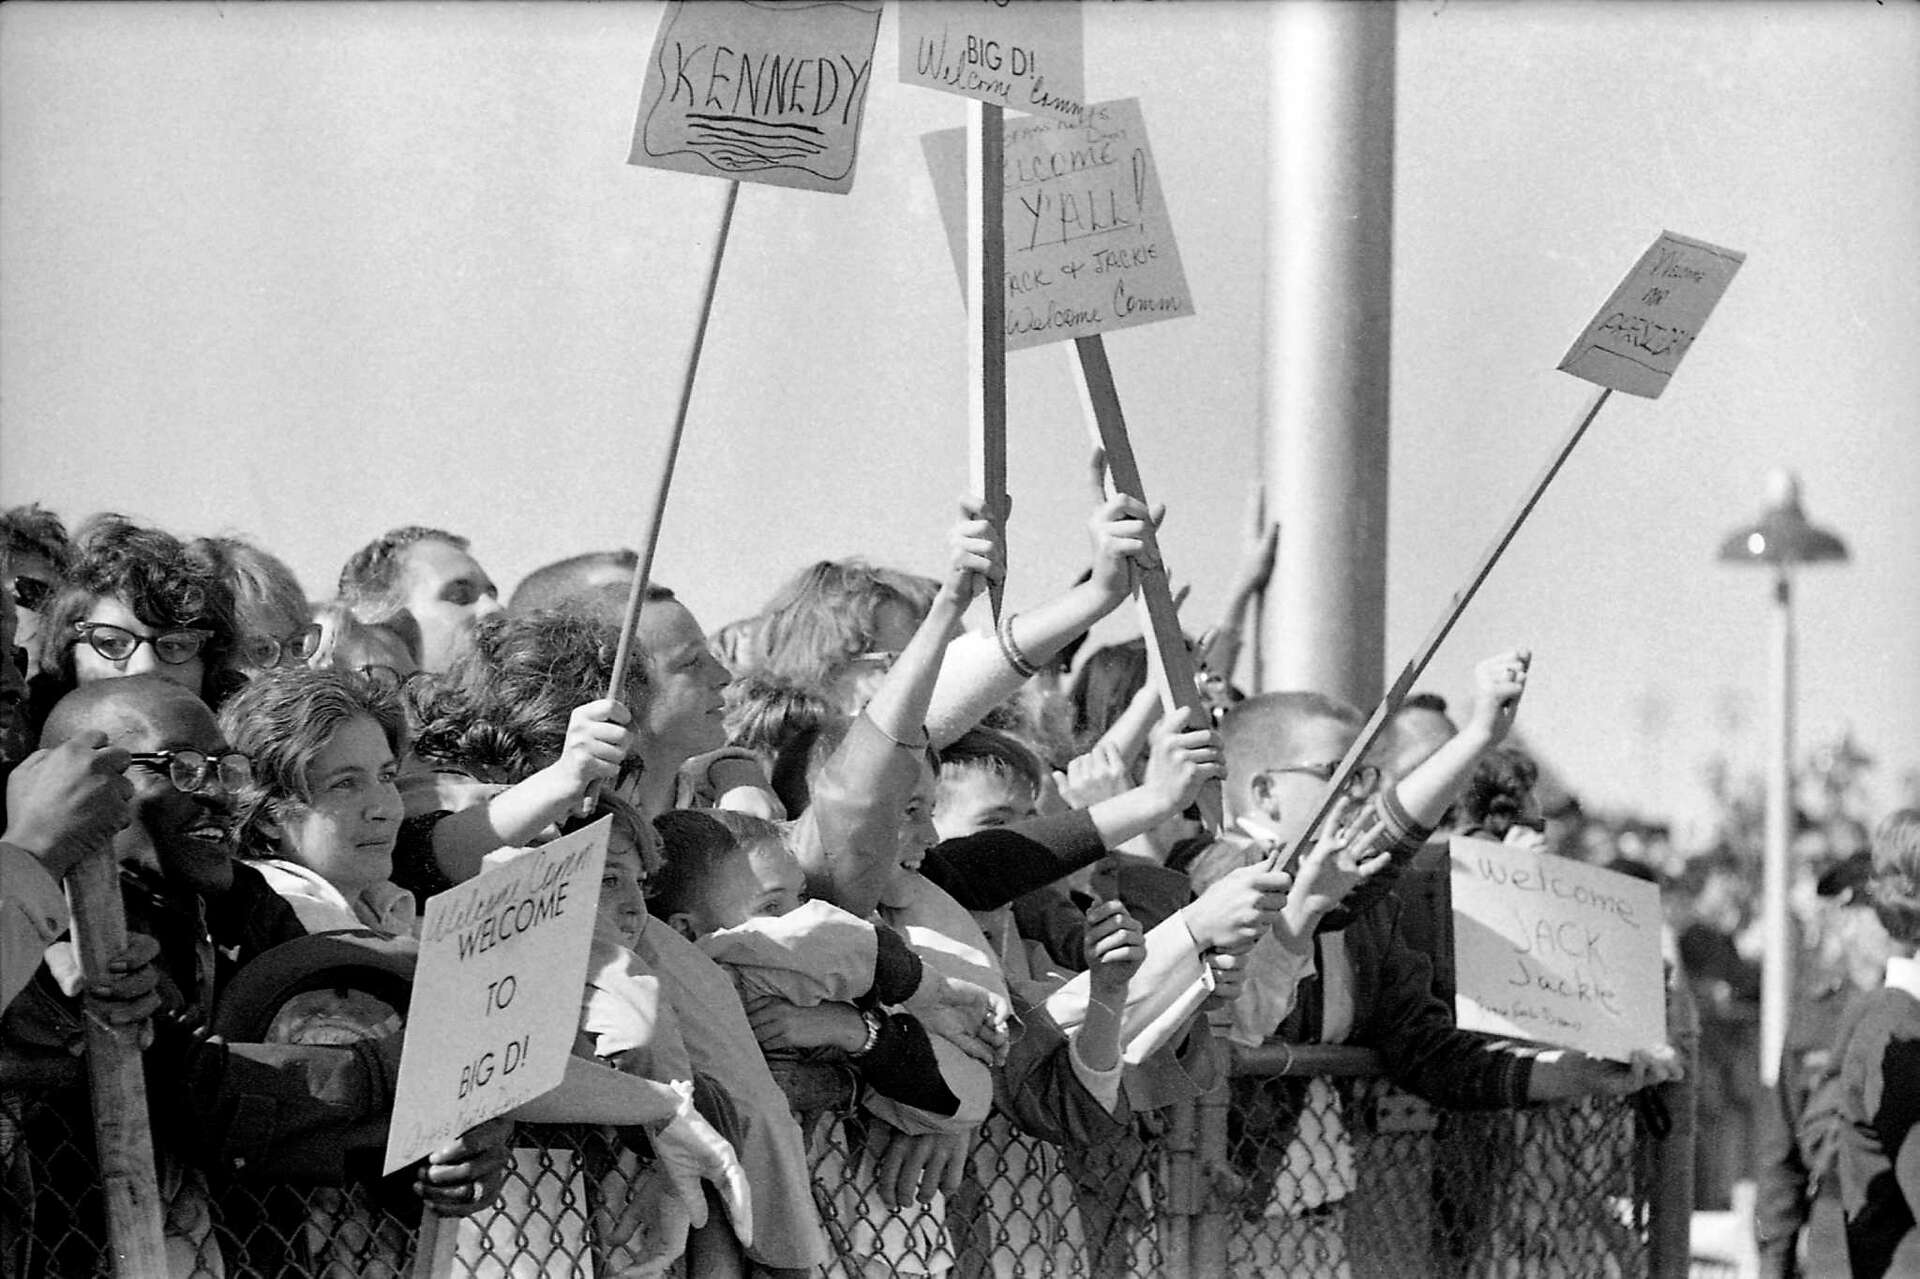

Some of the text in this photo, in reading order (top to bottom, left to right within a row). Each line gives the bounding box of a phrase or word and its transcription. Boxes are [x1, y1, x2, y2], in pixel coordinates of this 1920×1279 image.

[669, 41, 869, 124] KENNEDY
[967, 34, 1035, 80] BIG D!
[1003, 142, 1118, 183] LCOME
[1004, 270, 1052, 298] ACK
[1005, 301, 1102, 335] Welcome
[1478, 857, 1641, 929] Welcome
[457, 881, 570, 962] WELCOME
[1512, 908, 1606, 968] JACK
[485, 974, 518, 1018] TO
[457, 1034, 530, 1101] BIG D!
